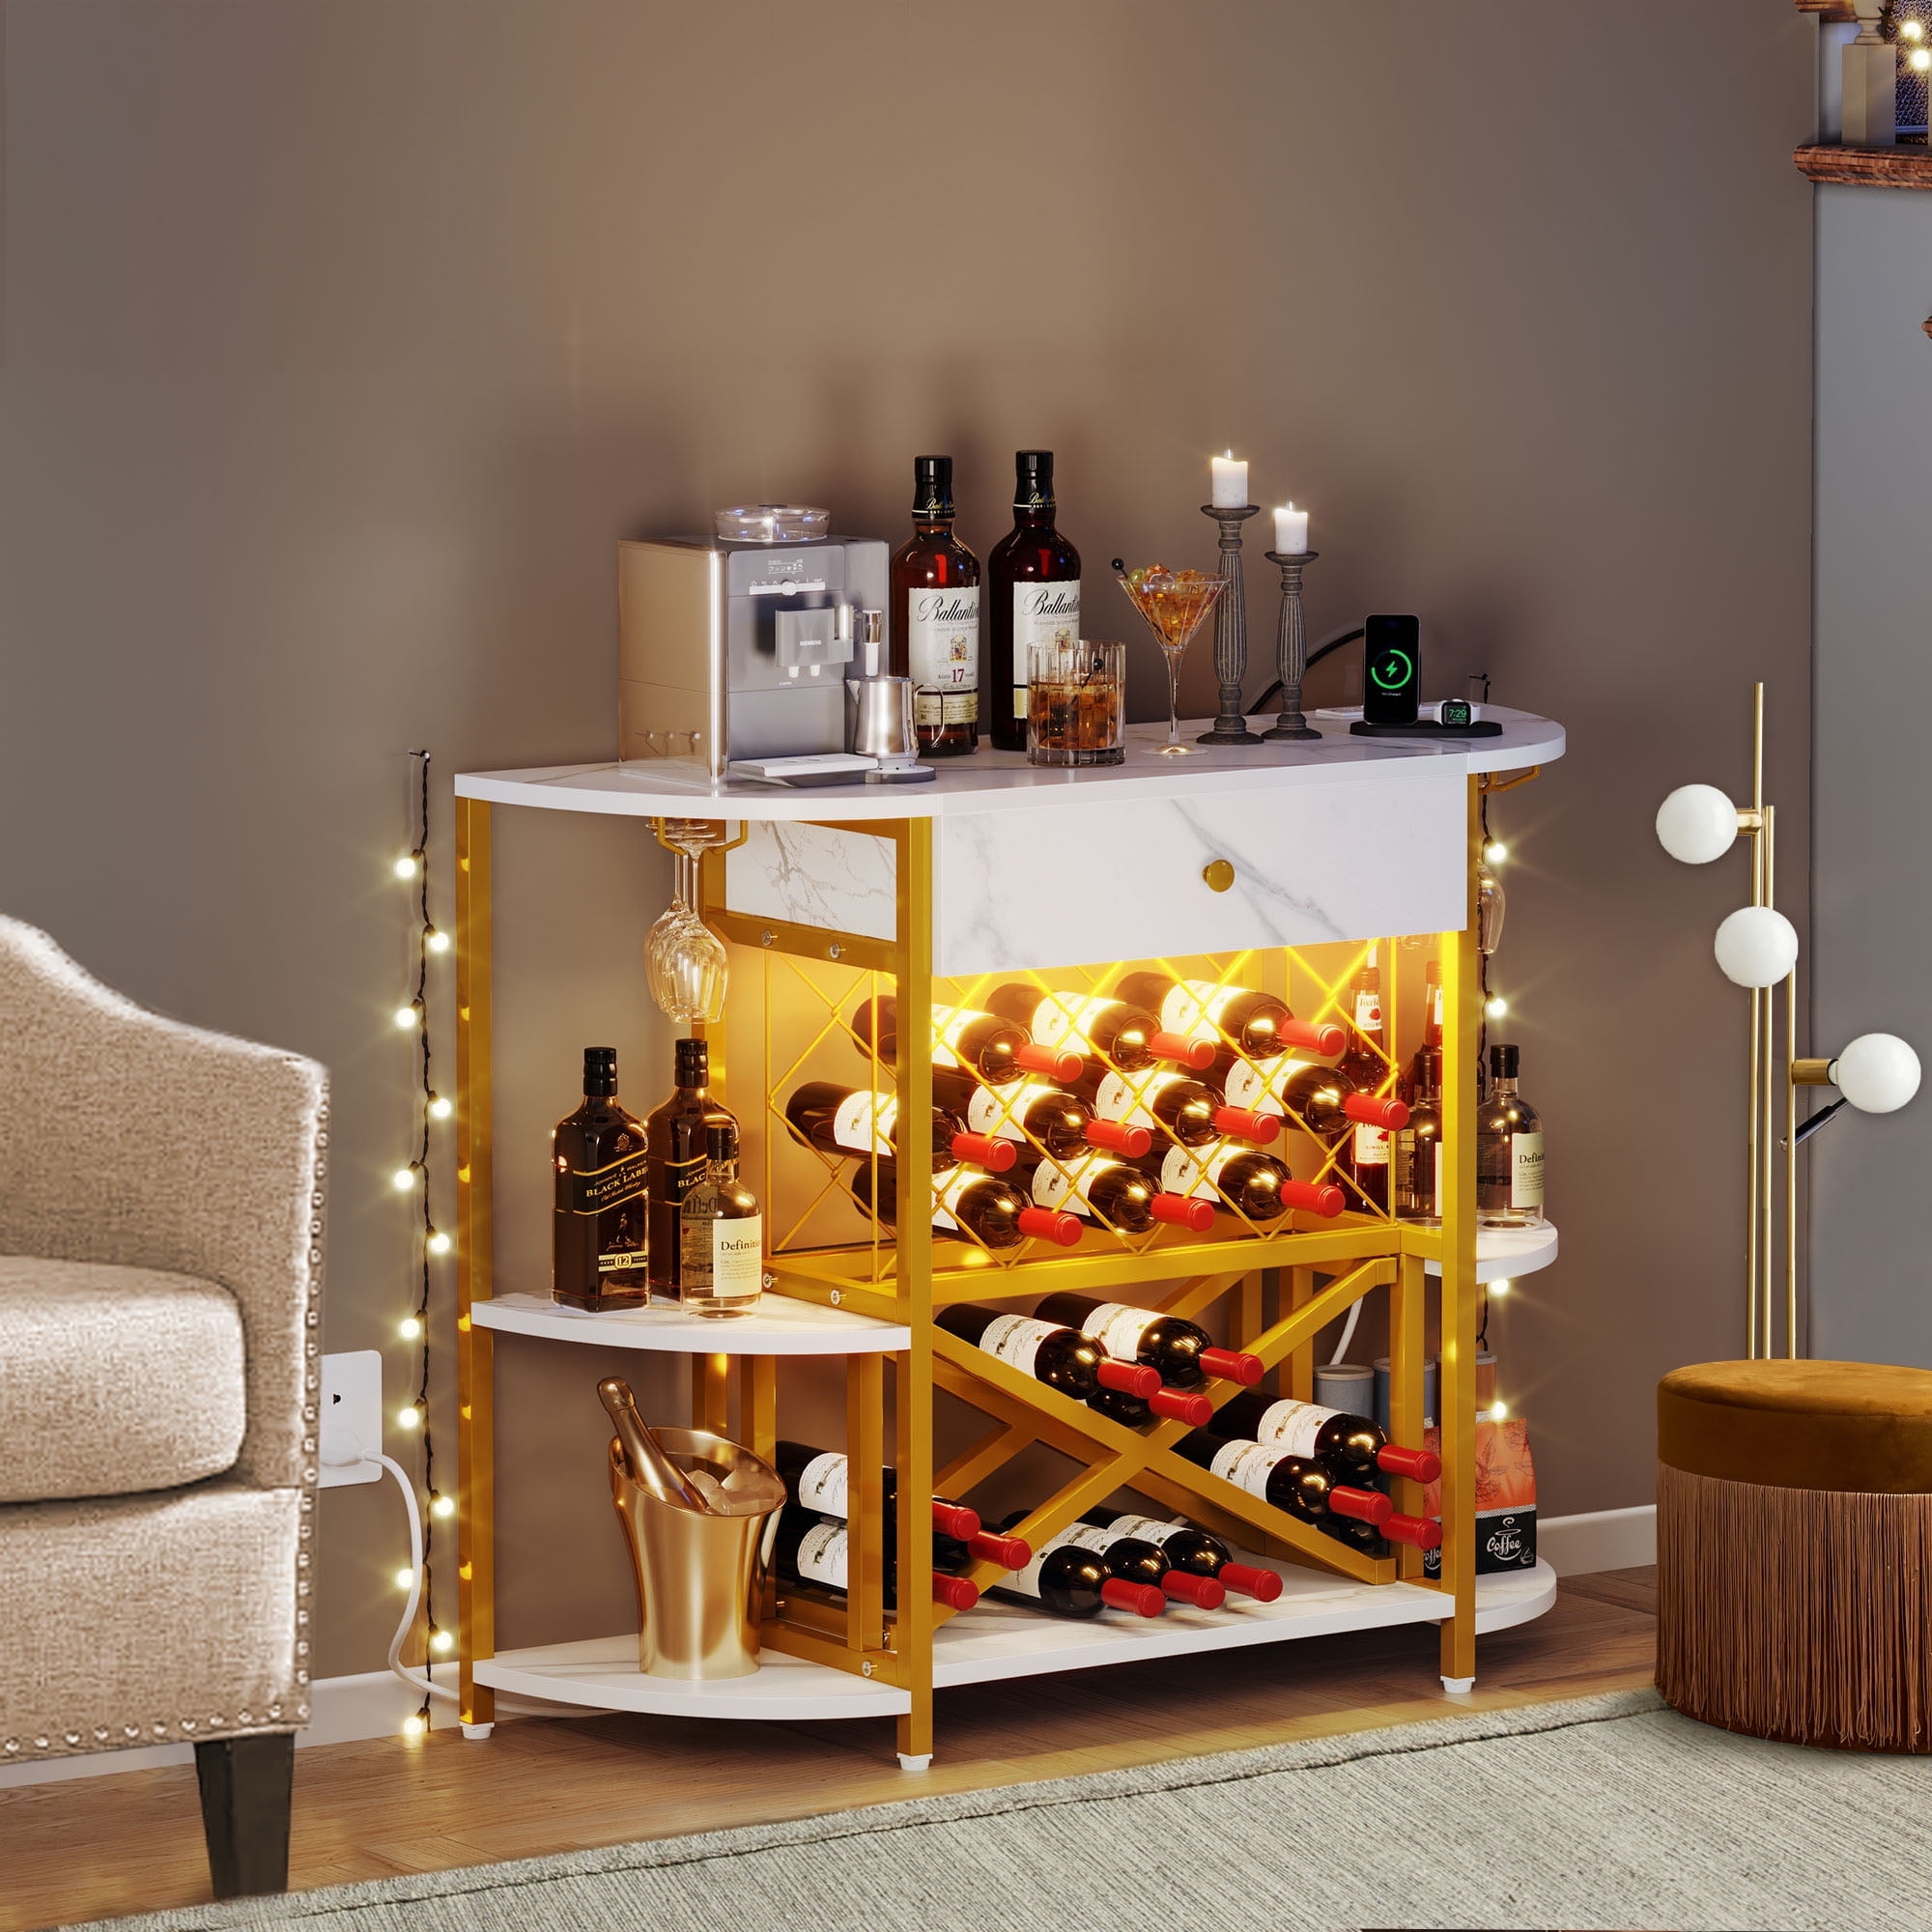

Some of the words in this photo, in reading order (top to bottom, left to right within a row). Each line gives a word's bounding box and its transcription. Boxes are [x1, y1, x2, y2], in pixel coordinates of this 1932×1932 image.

[952, 668, 965, 683] 17
[1449, 709, 1466, 718] 7:29
[585, 1179, 621, 1197] BLACK
[623, 1166, 648, 1183] LABE
[677, 1173, 706, 1188] BLAC
[618, 1256, 629, 1265] 12
[1486, 1535, 1522, 1555] Coffee
[1423, 1548, 1441, 1565] offe
